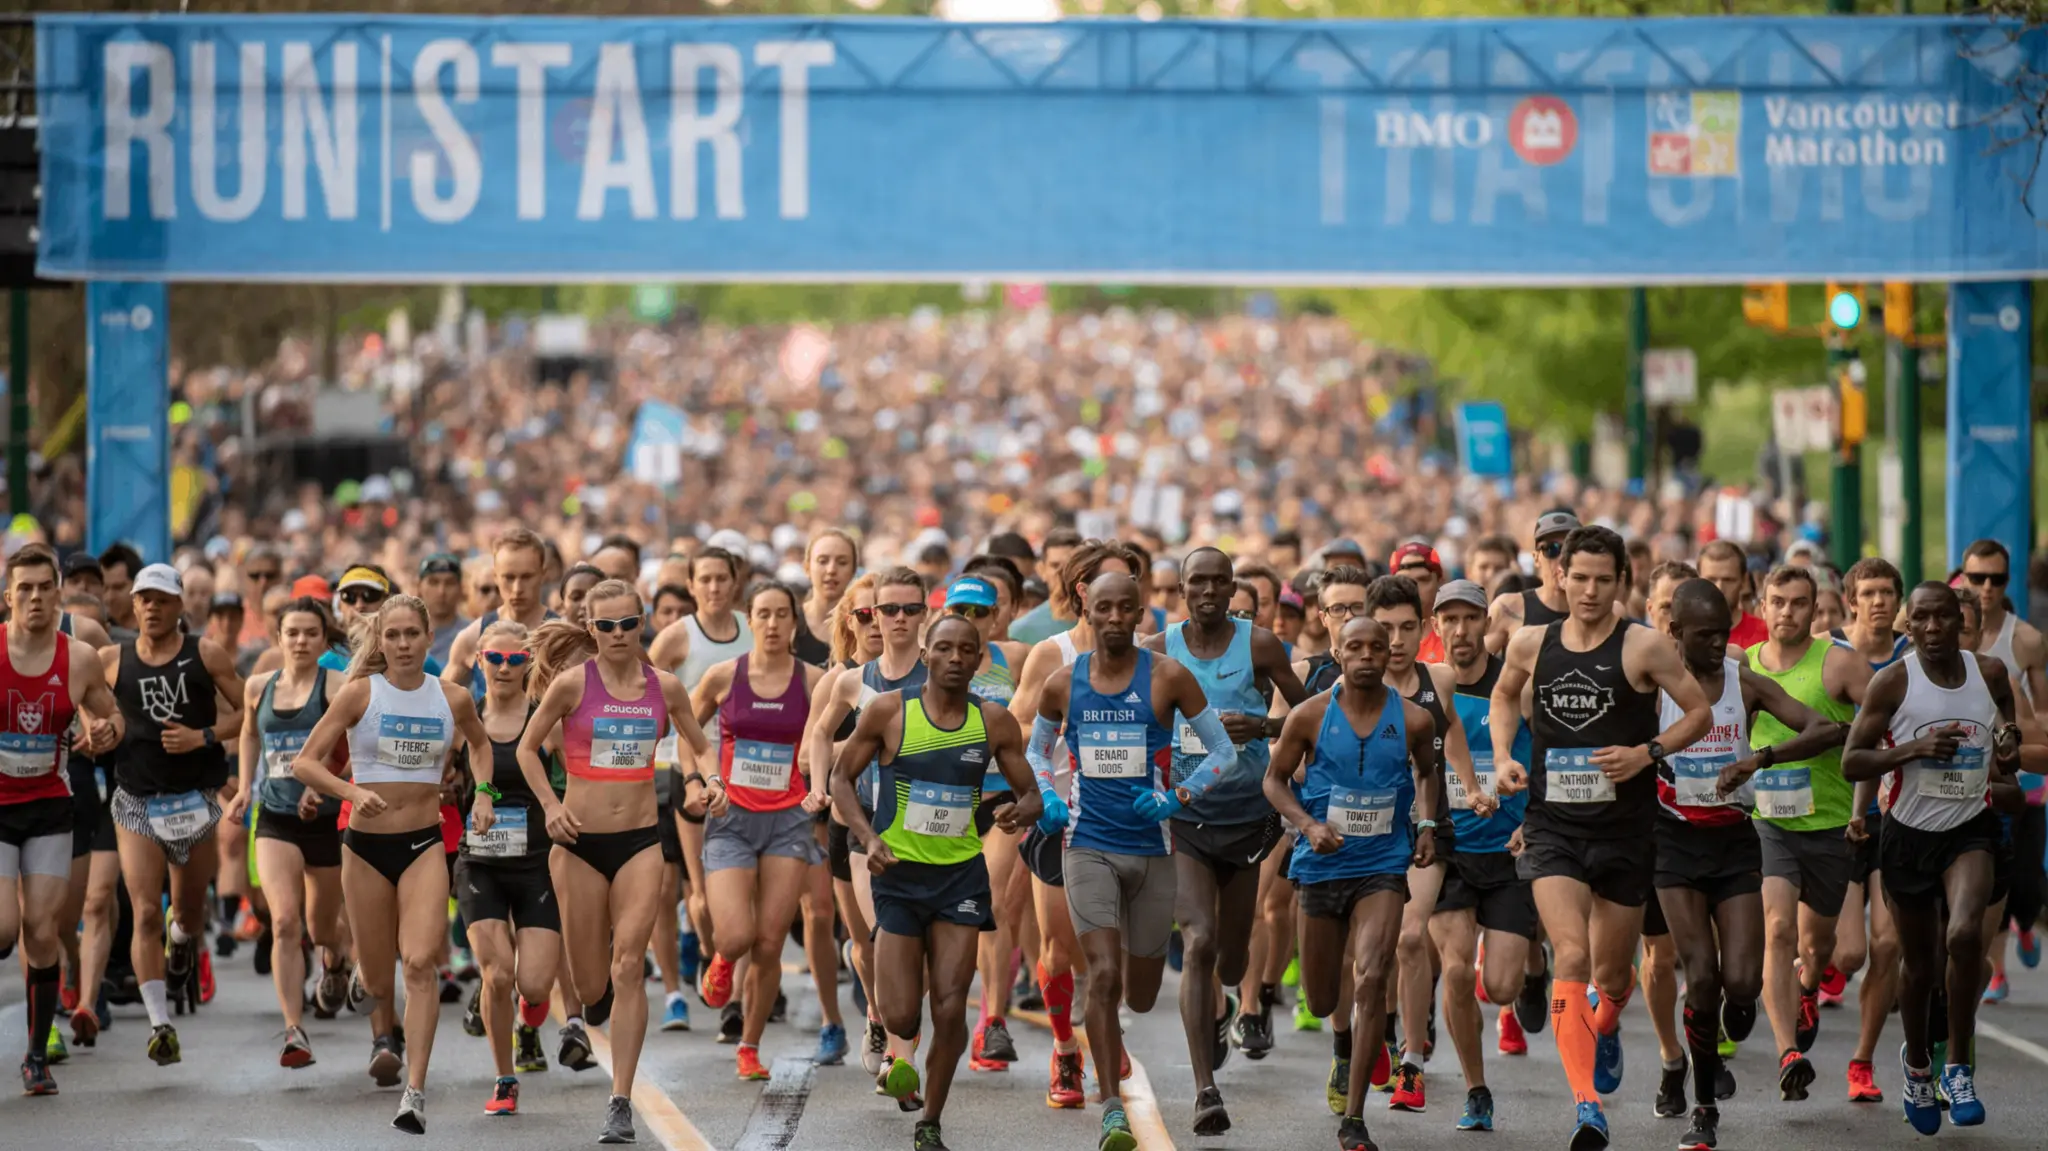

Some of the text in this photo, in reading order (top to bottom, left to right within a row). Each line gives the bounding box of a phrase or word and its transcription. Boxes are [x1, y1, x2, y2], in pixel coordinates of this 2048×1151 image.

[1764, 96, 1962, 131] Vancouver
[104, 39, 836, 224] RUN START
[1375, 110, 1493, 149] BMO
[1764, 131, 1946, 166] Marathon
[1551, 693, 1598, 709] M2M
[603, 704, 653, 717] saucony
[1082, 710, 1136, 722] BRITISH
[394, 740, 430, 753] T-FIERCE
[397, 754, 421, 765] 10050
[611, 755, 635, 765] 10066
[1094, 749, 1128, 761] BENARD
[741, 761, 783, 776] CHANTELLE
[1097, 763, 1123, 774] 10005
[1559, 773, 1600, 785] ANTHONY
[1943, 772, 1965, 783] PAUL
[1565, 787, 1592, 799] 10010
[933, 808, 949, 820] KIP
[1345, 811, 1379, 822] TOWETT
[924, 821, 950, 834] 10007
[1347, 823, 1373, 834] 10000
[480, 830, 510, 843] CHERYL
